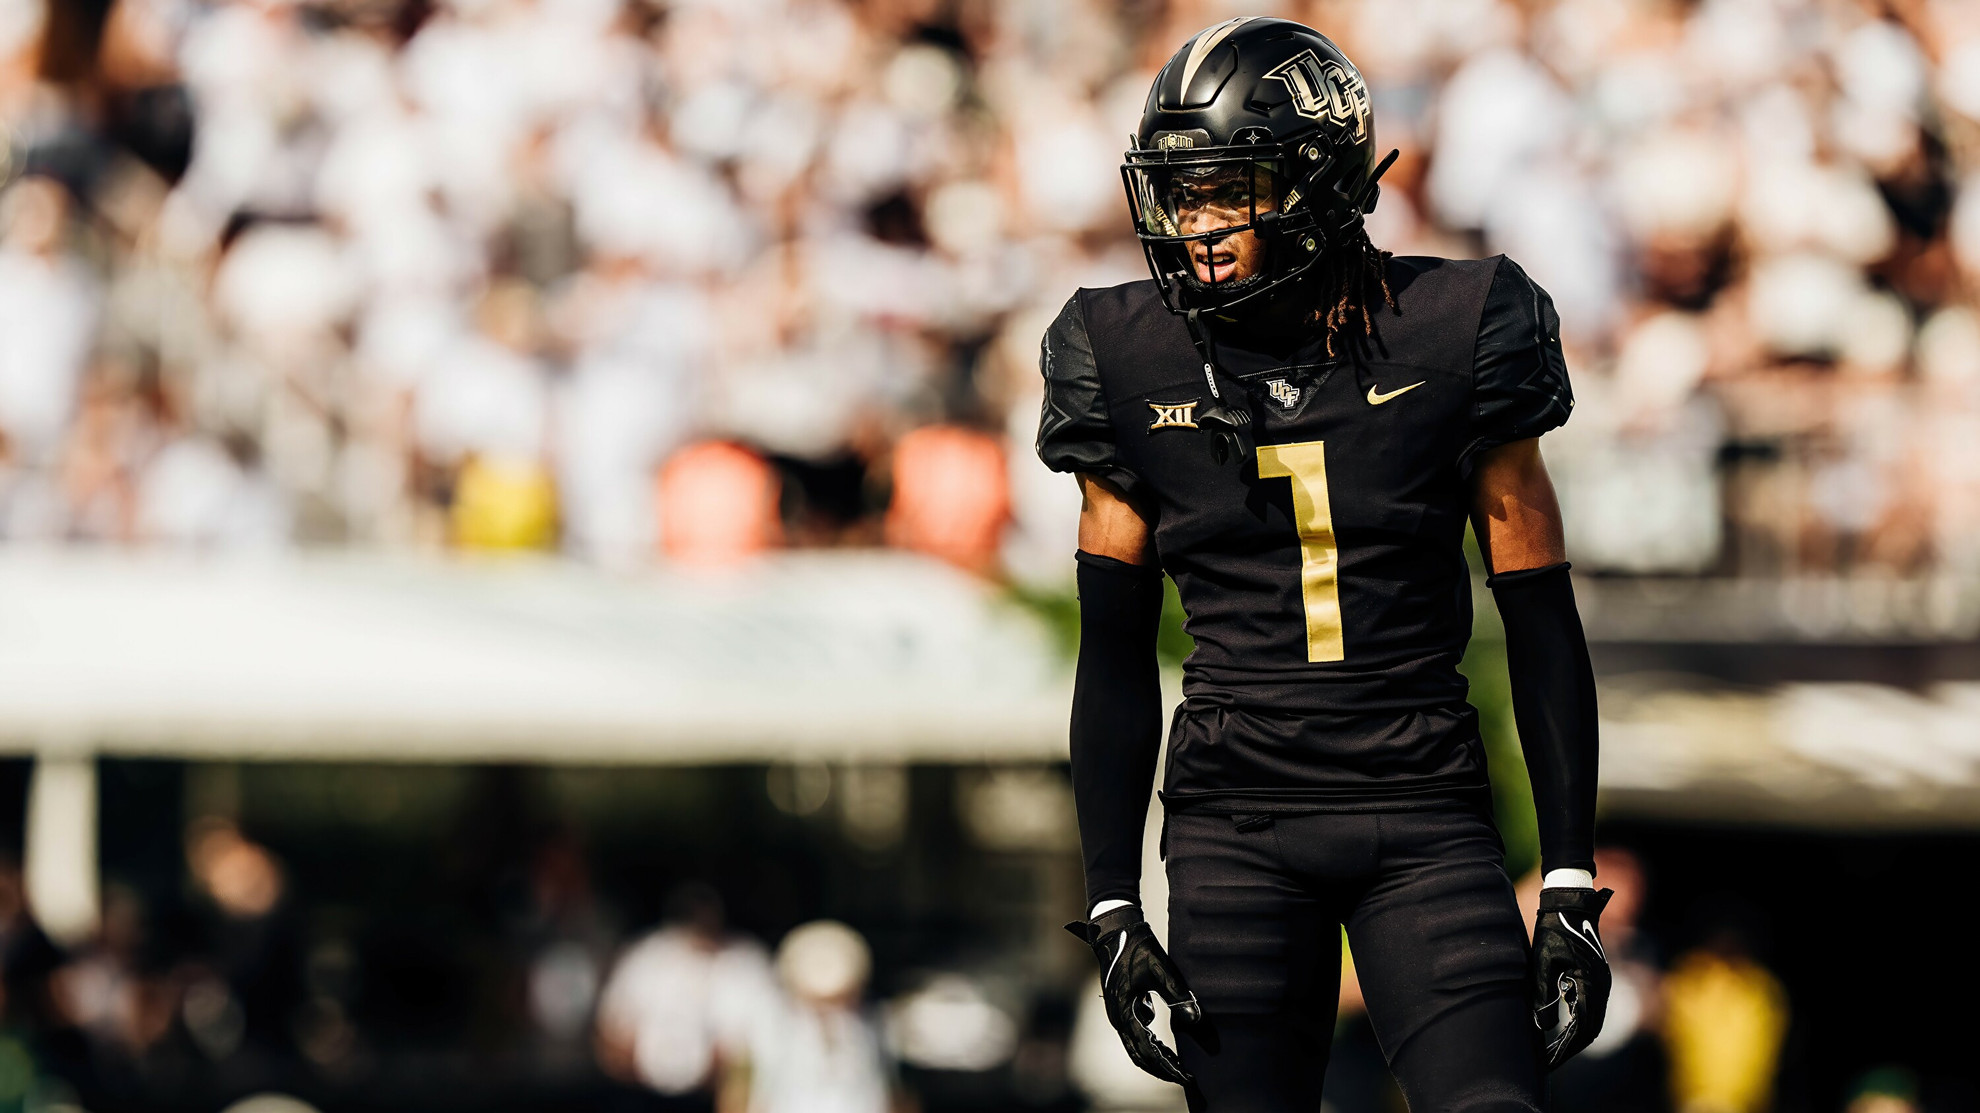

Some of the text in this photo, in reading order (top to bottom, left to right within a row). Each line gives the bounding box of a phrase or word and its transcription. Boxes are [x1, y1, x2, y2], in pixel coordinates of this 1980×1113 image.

[1270, 49, 1370, 143] UCF
[1149, 401, 1199, 429] XII
[1268, 380, 1299, 406] UCF
[1256, 440, 1345, 663] 1
